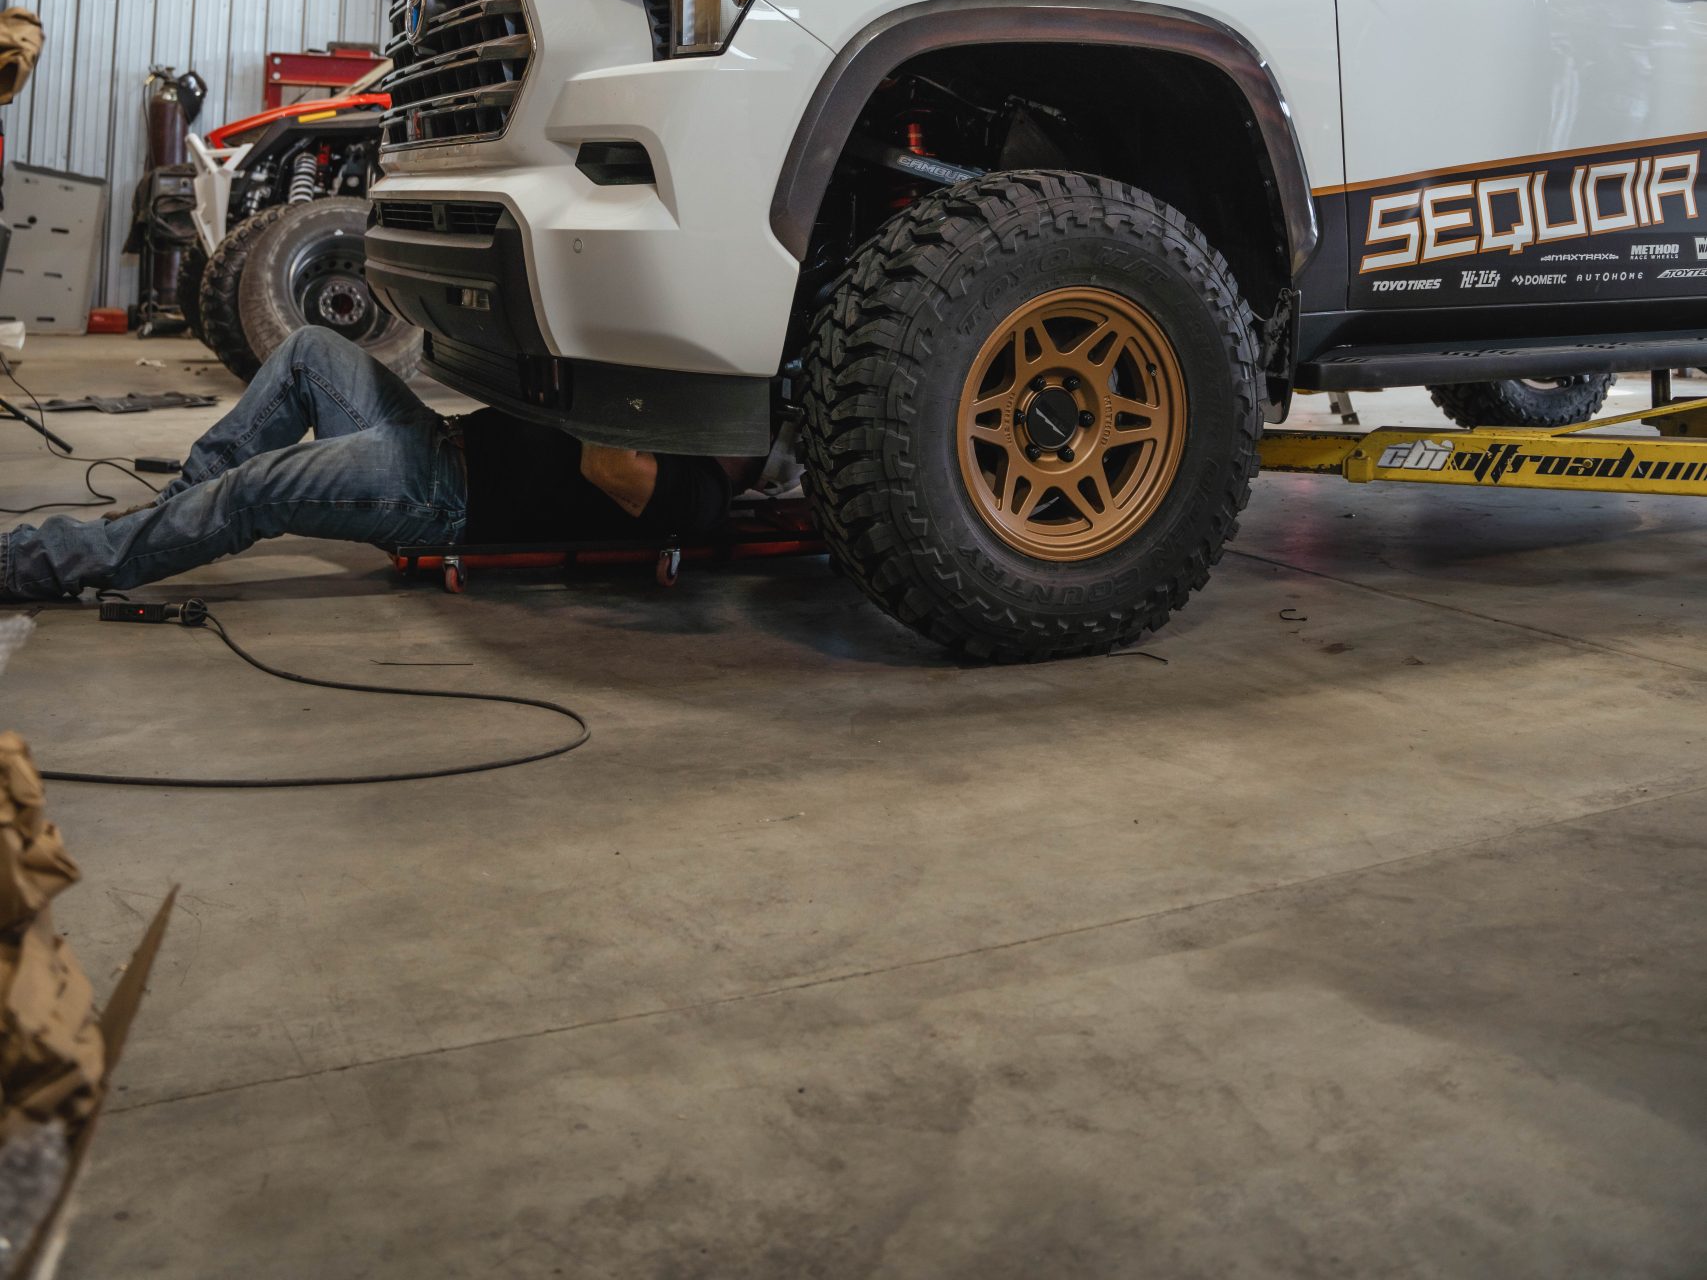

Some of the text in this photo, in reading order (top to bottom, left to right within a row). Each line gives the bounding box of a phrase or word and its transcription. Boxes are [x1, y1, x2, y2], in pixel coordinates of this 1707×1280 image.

[1360, 150, 1700, 274] SEQUOIA
[1551, 253, 1610, 261] MAXTRAX
[1630, 244, 1680, 255] METHOD
[958, 246, 1073, 337] TOYO
[1460, 270, 1500, 288] Hi-Lift
[1524, 274, 1567, 285] DOMETIC
[1576, 271, 1644, 282] AUTOHOME
[1100, 394, 1113, 446] METHOD
[1377, 440, 1635, 484] cbi offroad
[957, 542, 1142, 606] COUNTRY
